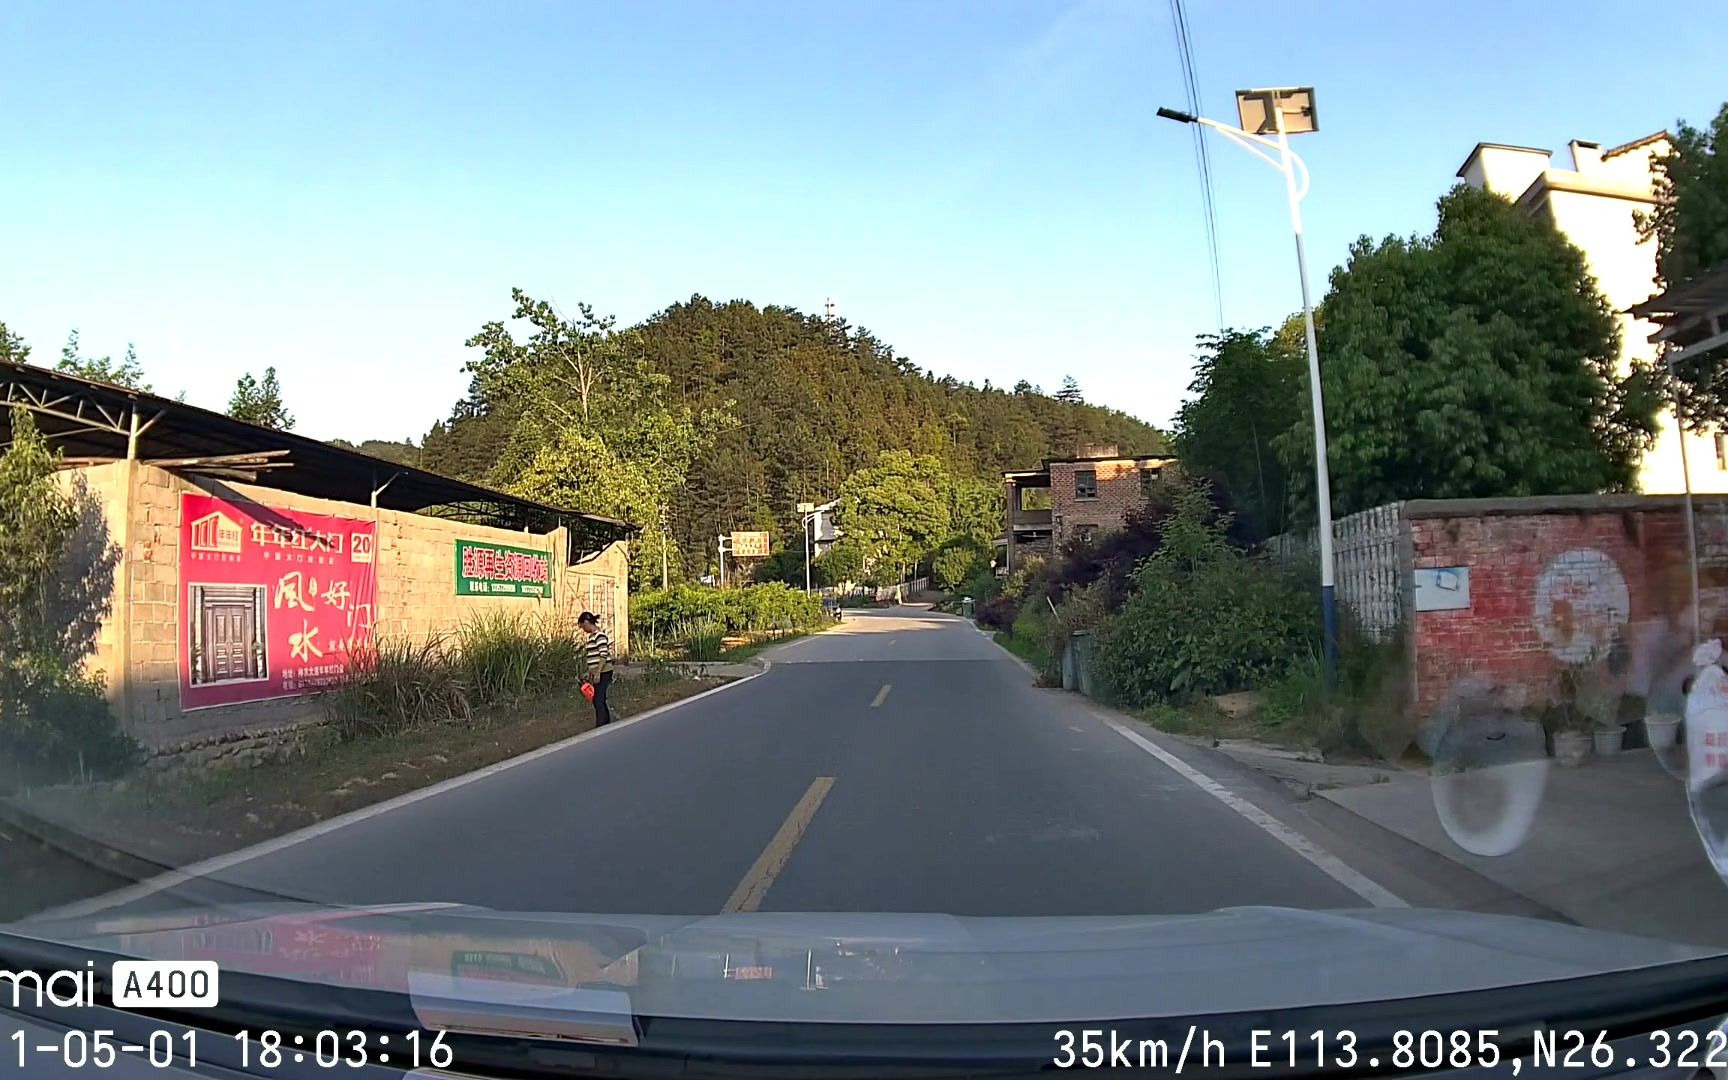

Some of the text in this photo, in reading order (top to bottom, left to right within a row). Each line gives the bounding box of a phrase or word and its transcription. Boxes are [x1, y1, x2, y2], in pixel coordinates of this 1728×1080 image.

[250, 522, 343, 554] 年年红大门
